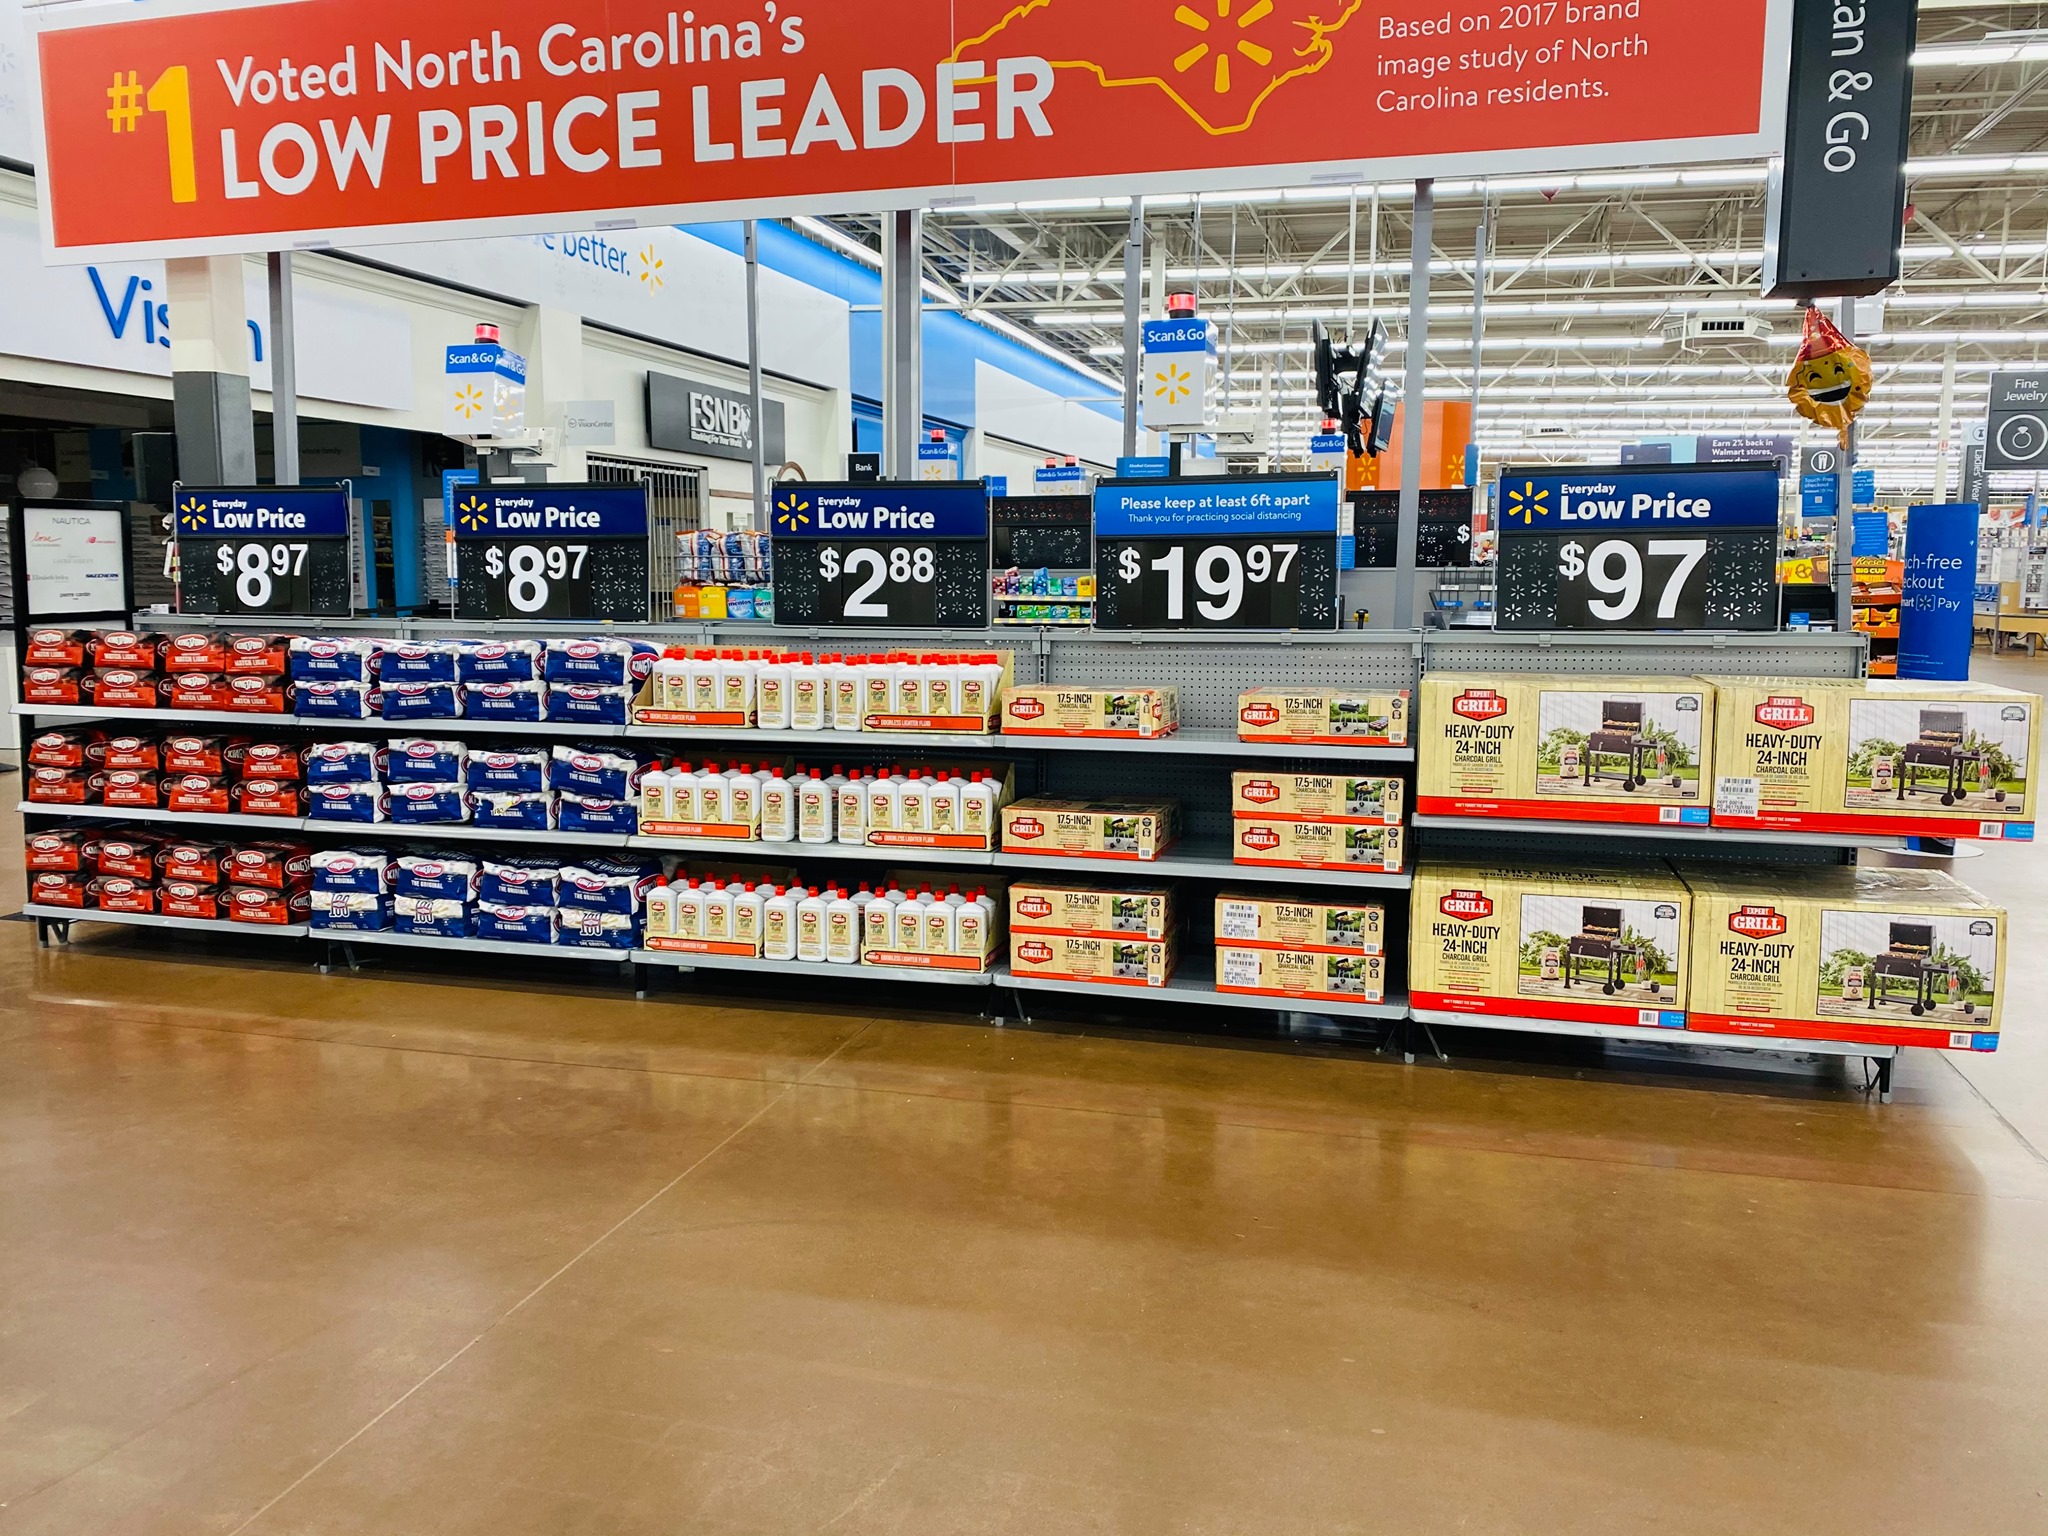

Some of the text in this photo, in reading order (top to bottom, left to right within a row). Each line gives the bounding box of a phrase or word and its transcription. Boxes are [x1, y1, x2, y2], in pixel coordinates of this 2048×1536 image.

[1378, 0, 1641, 40] Based on 2017 brand
[217, 1, 806, 107] Voted North Carolina's
[1377, 33, 1648, 78] image study of North
[1828, 69, 1874, 103] &
[1376, 76, 1609, 113] Carolina residents.
[106, 66, 197, 203] #1
[219, 56, 1055, 200] LOW PRICE LEADER
[1823, 112, 1869, 175] Go
[87, 266, 263, 362] Visn
[2015, 379, 2039, 389] Fine
[2004, 390, 2047, 403] Jewelry
[689, 391, 742, 436] FSNB
[1732, 439, 1744, 447] 2%
[1745, 439, 1764, 447] back
[855, 463, 873, 472] Bank
[1561, 483, 1617, 495] Everyday
[212, 499, 247, 510] Everyday
[495, 498, 534, 508] Everyday
[818, 496, 861, 508] Everyday
[1121, 493, 1311, 512] Please keep at least 6ft apart
[1560, 492, 1711, 520] Low Price
[52, 517, 91, 525] NAUTICA
[212, 507, 306, 528] Low Price
[495, 506, 600, 528] Low Price
[818, 506, 935, 529] Low Price
[1128, 510, 1302, 524] Thank you for practicing social distancing
[1457, 524, 1470, 543] $
[1938, 598, 1961, 612] Pay
[1057, 693, 1092, 704] 17.5-INCH
[1470, 690, 1492, 698] EXPERT
[1284, 697, 1323, 710] 17.5-INCH
[1456, 699, 1502, 713] GRILL
[1773, 698, 1796, 706] EXPERT
[1013, 705, 1042, 715] GRILL
[1243, 708, 1277, 721] GRILL
[1759, 707, 1809, 721] GRILL
[1445, 724, 1514, 740] HEAVY-DUTY
[1456, 740, 1501, 755] 24-INCH
[1745, 733, 1822, 749] HEAVY-DUTY
[1454, 755, 1502, 763] CHARCOAL GRILL
[1757, 750, 1807, 766] 24-INCH
[1756, 765, 1807, 775] CHARCOAL GRILL
[1294, 776, 1332, 789] 17.5-INCH
[1243, 787, 1278, 800] GRILL
[1057, 814, 1092, 825] 17.5-INCH
[1013, 824, 1041, 835] GRILL
[1065, 894, 1100, 906] 17.5-INCH
[1456, 891, 1477, 899] EXPERT
[1021, 903, 1050, 914] GRILL
[1275, 905, 1313, 918] 17.5-INCH
[1444, 900, 1488, 913] GRILL
[1747, 907, 1769, 916] EXPERT
[1733, 916, 1782, 931] GRILL
[1432, 923, 1500, 940] HEAVY-DUTY
[1066, 939, 1101, 952] 17.5-INCH
[1443, 939, 1488, 955] 24-INCH
[1720, 941, 1795, 959] HEAVY-DUTY
[1021, 948, 1050, 959] GRILL
[1276, 952, 1314, 965] 17.5-INCH
[1442, 953, 1488, 963] CHARCOAL GRILL
[1731, 957, 1780, 974] 24-INCH
[1730, 973, 1781, 983] CHARCOAL GRILL
